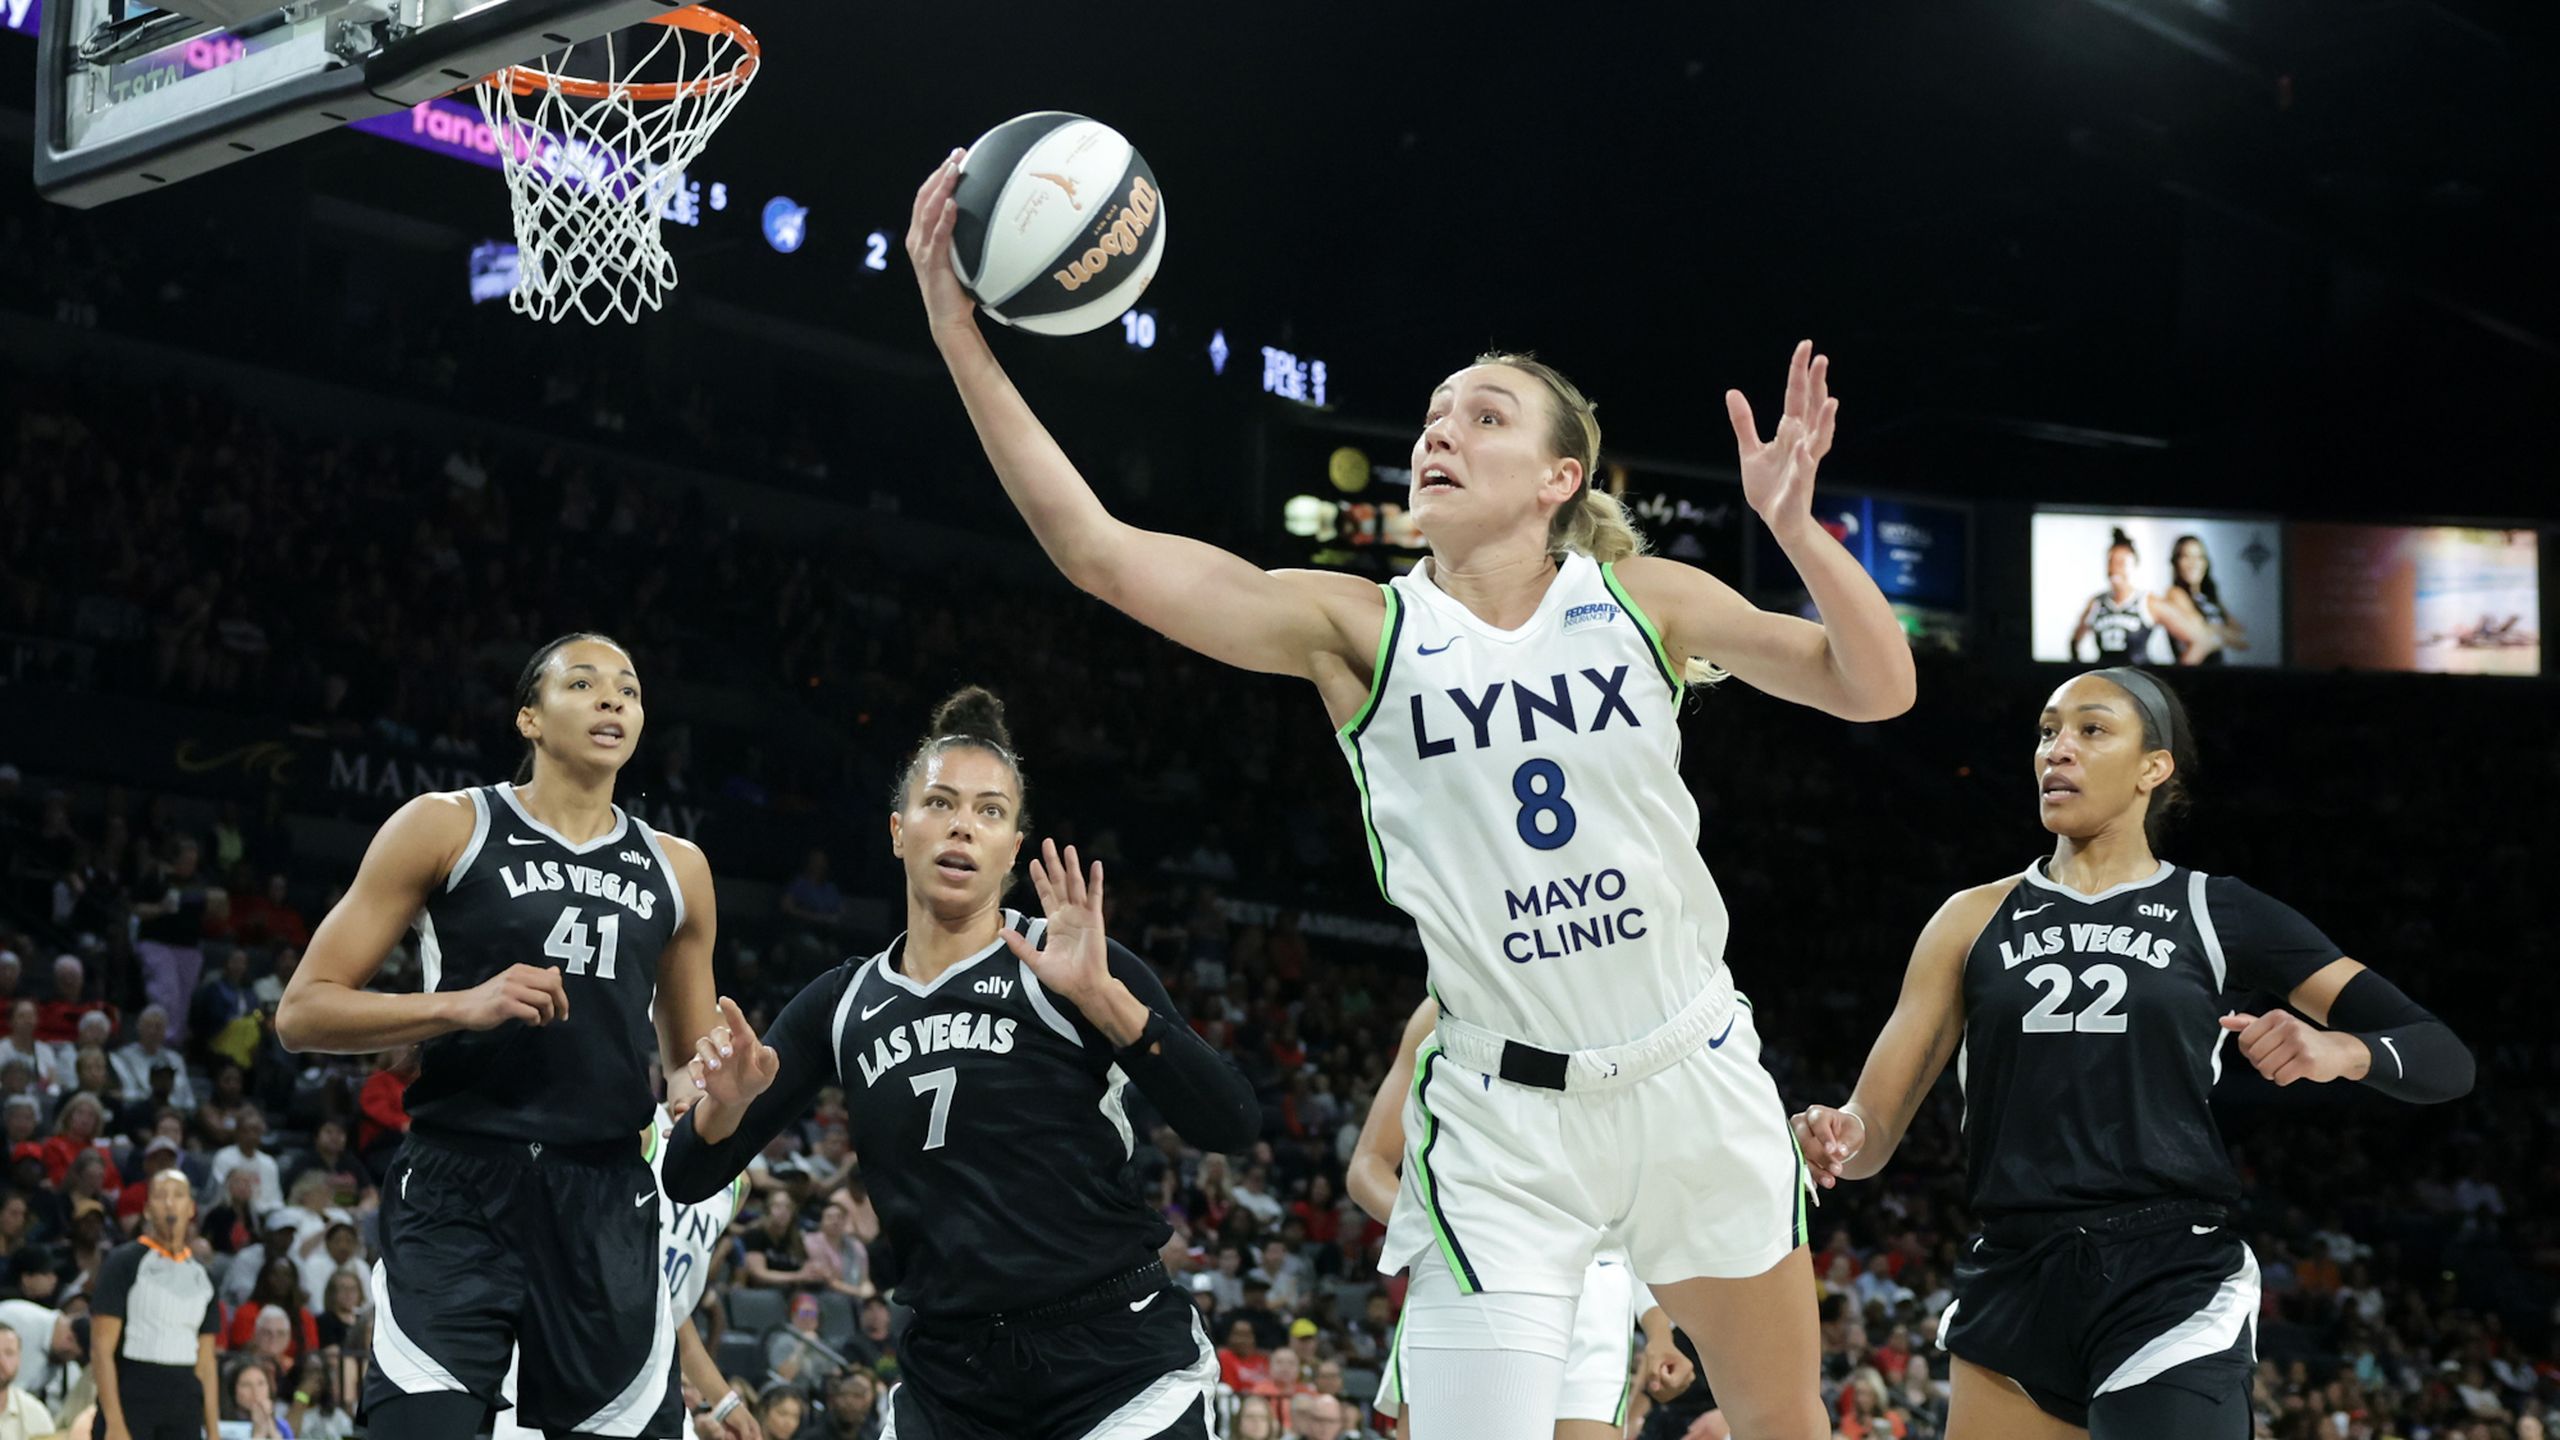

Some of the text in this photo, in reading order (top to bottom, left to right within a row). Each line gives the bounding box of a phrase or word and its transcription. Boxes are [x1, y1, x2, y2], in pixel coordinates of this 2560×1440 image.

[865, 232, 888, 271] 2
[1121, 309, 1156, 348] 10
[1410, 665, 1642, 760] LYNX
[329, 750, 482, 797] MAND
[1512, 758, 1577, 850] 8
[619, 850, 651, 870] ally
[499, 860, 657, 921] LAS VEGAS
[1504, 868, 1626, 920] MAYO
[2138, 904, 2178, 922] ally
[543, 905, 620, 980] 41
[1503, 908, 1648, 964] CLINIC
[1999, 923, 2177, 970] LAS VEGAS
[973, 976, 1014, 998] ally
[2022, 963, 2128, 1033] 22
[857, 1012, 1018, 1088] LAS VEGAS
[908, 1066, 957, 1151] 7
[659, 1202, 722, 1253] YNX
[664, 1246, 692, 1299] 10
